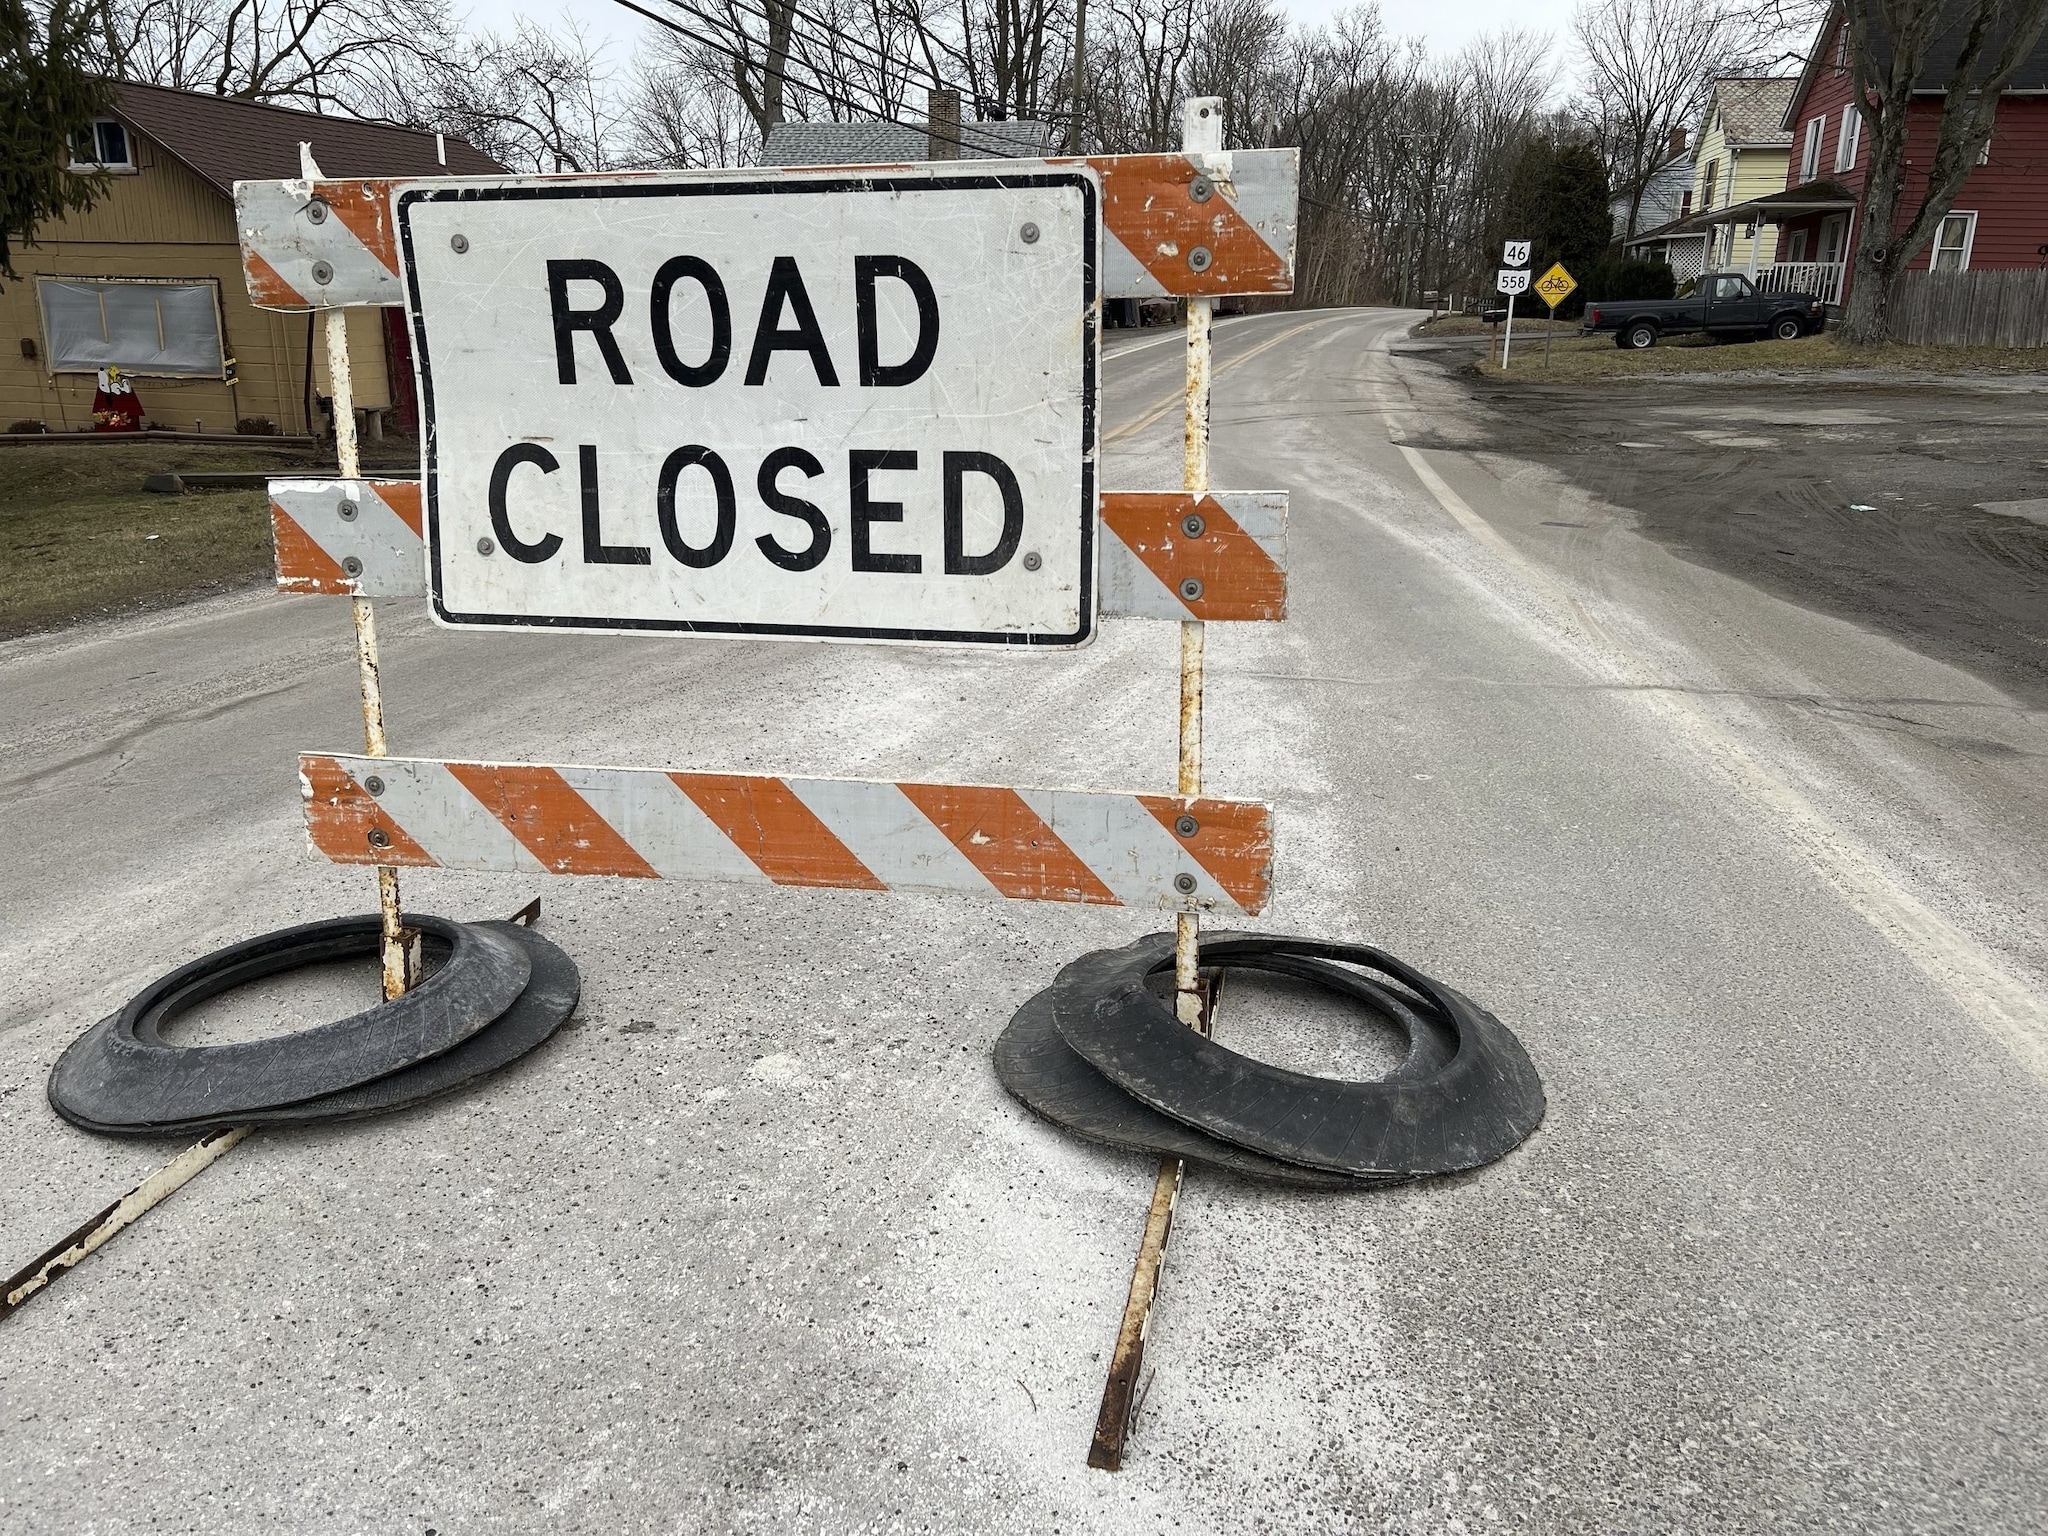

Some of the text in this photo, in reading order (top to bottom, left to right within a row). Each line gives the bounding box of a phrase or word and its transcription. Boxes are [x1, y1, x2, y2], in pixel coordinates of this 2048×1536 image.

[1501, 276, 1525, 288] 558
[1507, 246, 1526, 260] 46
[547, 255, 940, 387] ROAD
[489, 442, 1024, 575] CLOSED
